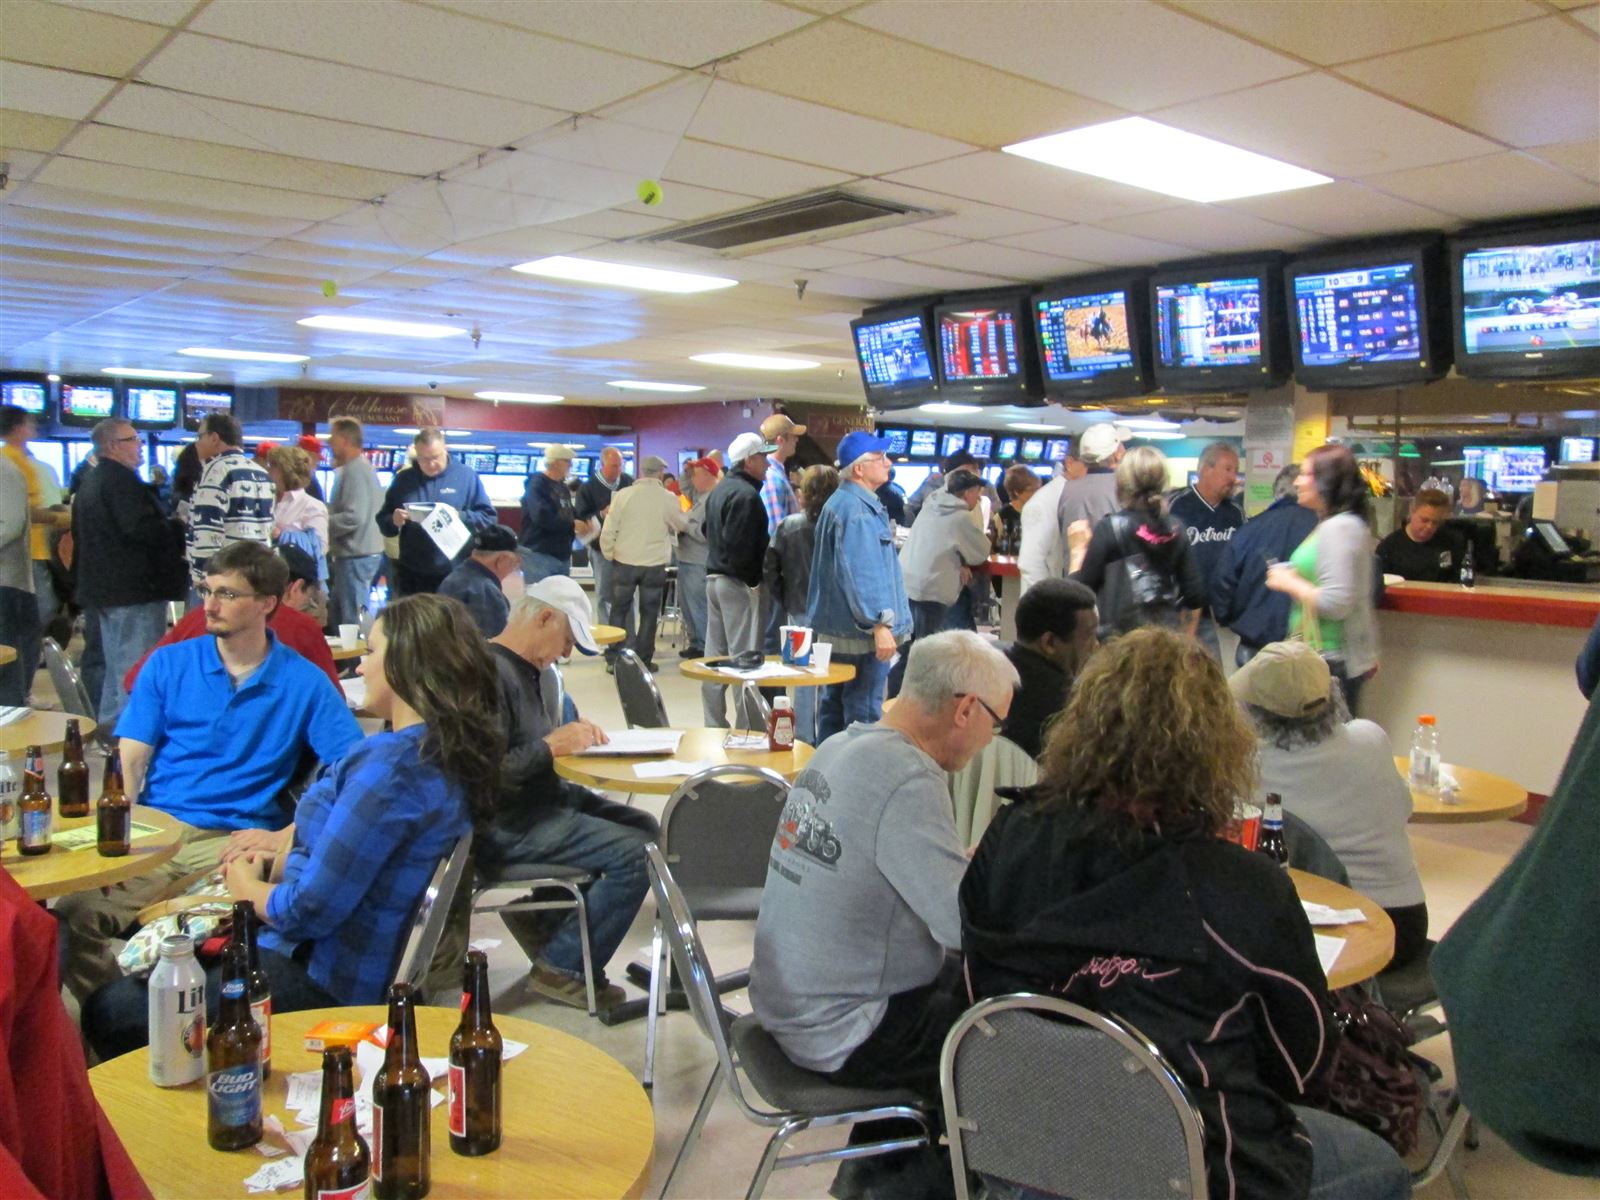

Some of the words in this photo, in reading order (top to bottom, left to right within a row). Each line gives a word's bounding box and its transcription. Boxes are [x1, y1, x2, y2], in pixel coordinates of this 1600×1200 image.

[832, 415, 872, 427] GENERAL
[1186, 526, 1237, 546] Detroit
[177, 985, 204, 1014] Lit
[216, 1071, 255, 1084] BUD
[211, 1078, 258, 1094] LIGHT
